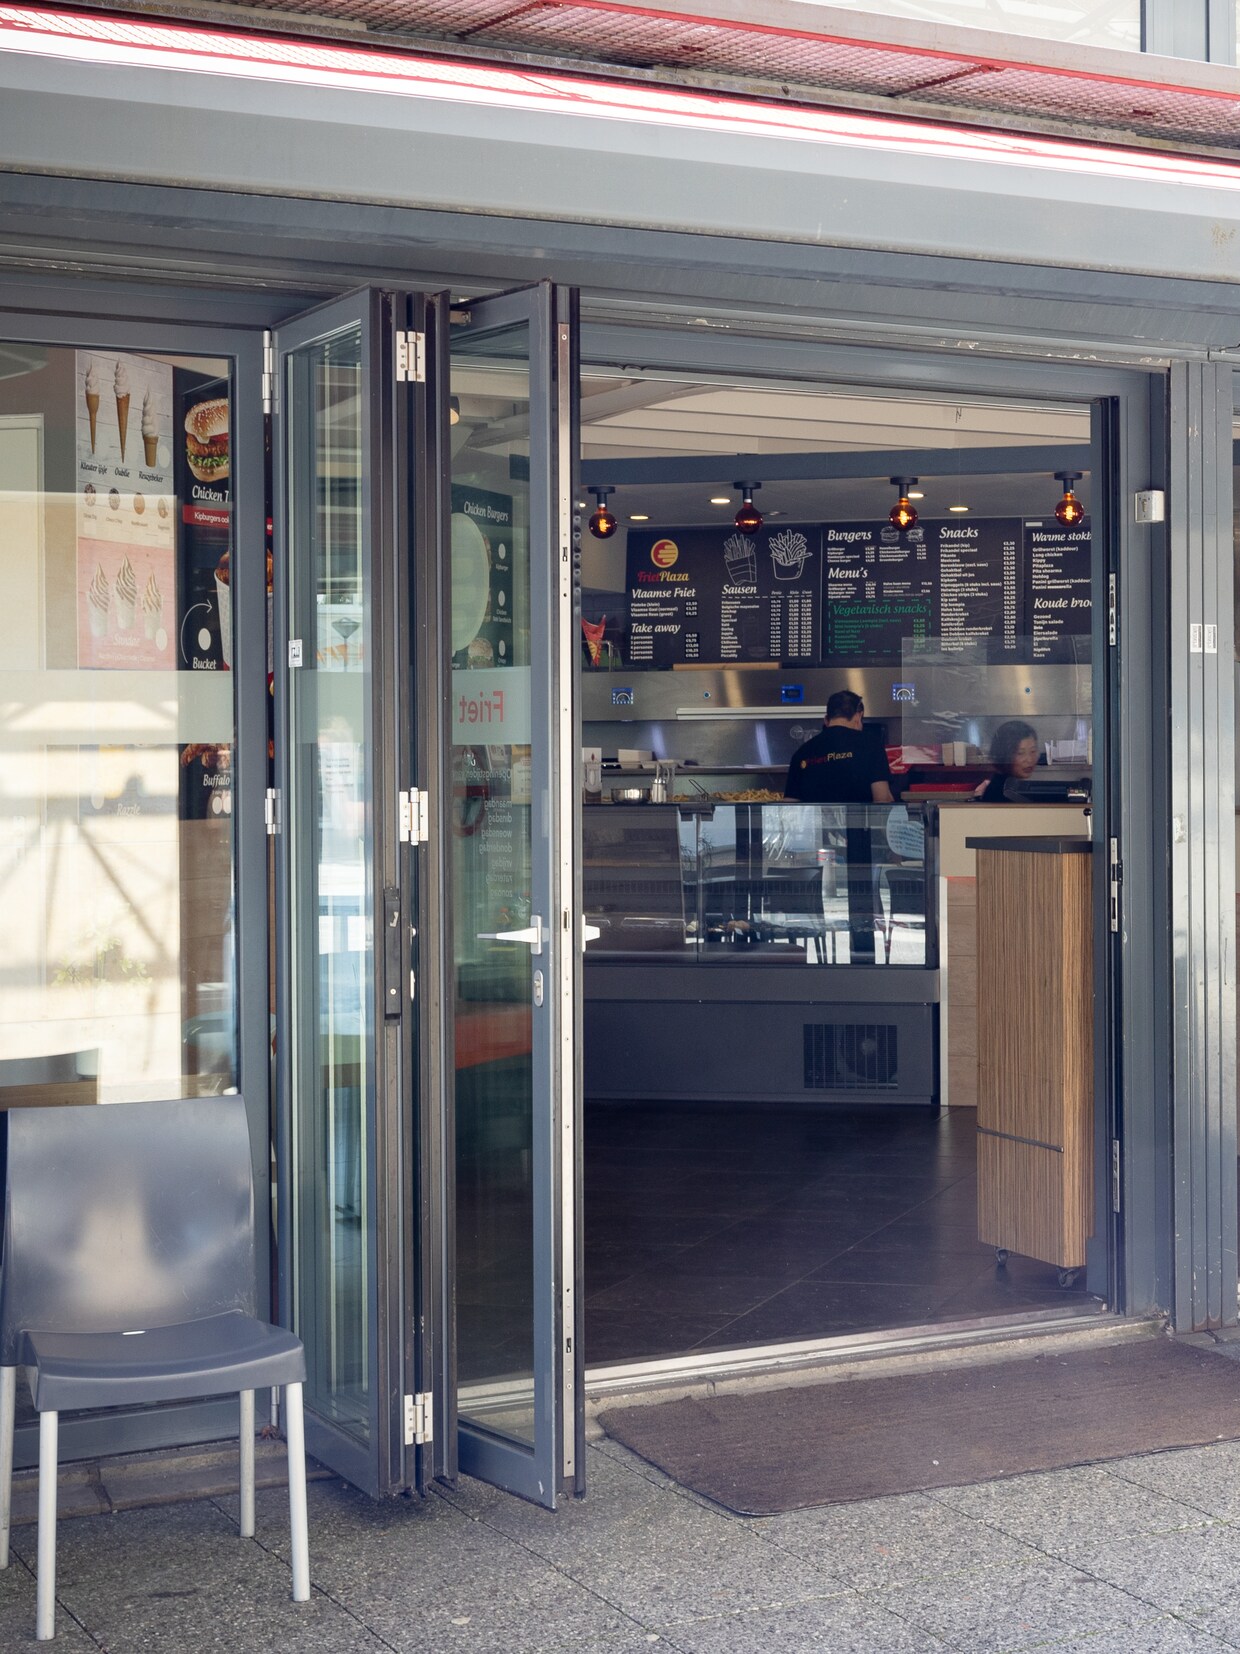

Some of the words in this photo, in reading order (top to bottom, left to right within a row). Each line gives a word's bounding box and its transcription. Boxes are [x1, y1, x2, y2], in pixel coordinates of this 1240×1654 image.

[115, 467, 130, 478] Oublie
[192, 485, 220, 502] Chicken
[464, 500, 486, 518] Chicken
[487, 506, 509, 523] Burgers
[194, 512, 220, 523] Kipburgers
[828, 530, 872, 543] Burgers
[939, 527, 979, 539] Snacks
[1033, 533, 1066, 542] Warme
[638, 571, 689, 582] FrietPlaza
[828, 567, 869, 578] Menu's
[632, 589, 672, 599] Vlaamse
[674, 588, 696, 598] Friet
[722, 584, 757, 594] Sausen
[1034, 598, 1068, 609] Koude
[834, 604, 891, 616] Vegetarisch
[894, 604, 927, 613] snacks
[631, 623, 652, 633] Take
[655, 624, 681, 634] away
[192, 657, 217, 670] Bucket
[203, 773, 231, 788] Buffalo
